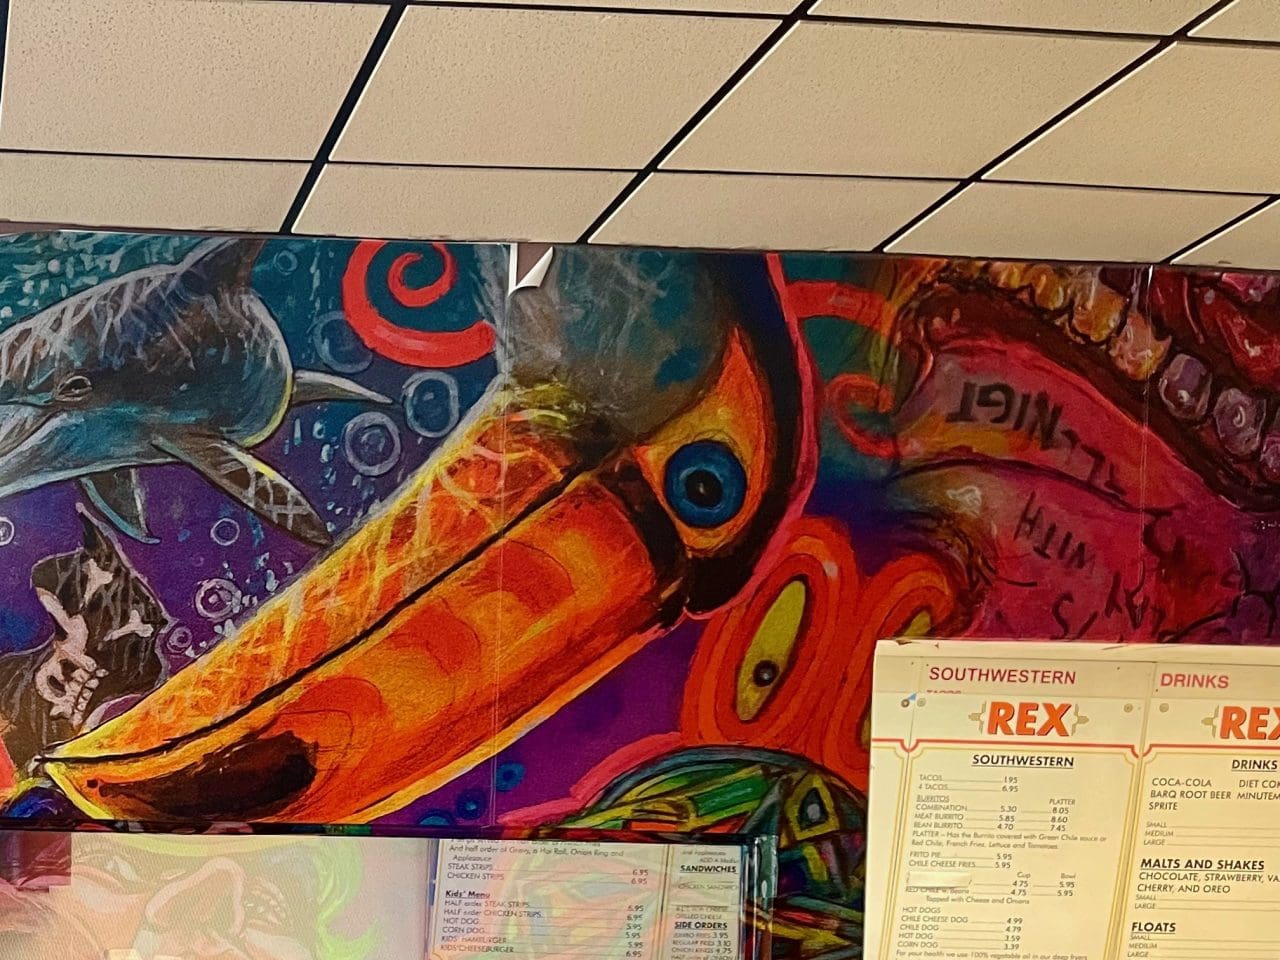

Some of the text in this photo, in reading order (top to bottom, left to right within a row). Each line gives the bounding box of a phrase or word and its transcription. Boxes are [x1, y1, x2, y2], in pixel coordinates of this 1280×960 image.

[929, 667, 1076, 684] SOUTHWESTERN
[1160, 673, 1229, 688] DRINKS
[987, 701, 1072, 736] REX
[972, 755, 1074, 767] SOUTHWESTERN
[1232, 760, 1278, 770] DRINKS
[1152, 778, 1212, 787] COCA-COLA
[1239, 780, 1259, 788] DIET
[1151, 790, 1231, 799] BARQ ROOT BEER
[1149, 802, 1178, 810] SPRITE
[680, 865, 736, 873] SANDWICHES
[1141, 859, 1265, 870] MALTS AND SHAKES
[1139, 872, 1202, 882] CHOCOLATE,
[1204, 874, 1264, 883] STRAWBERRY,
[1137, 884, 1175, 894] CHERRY,
[1178, 885, 1200, 893] AND
[1131, 922, 1176, 932] FLOATS
